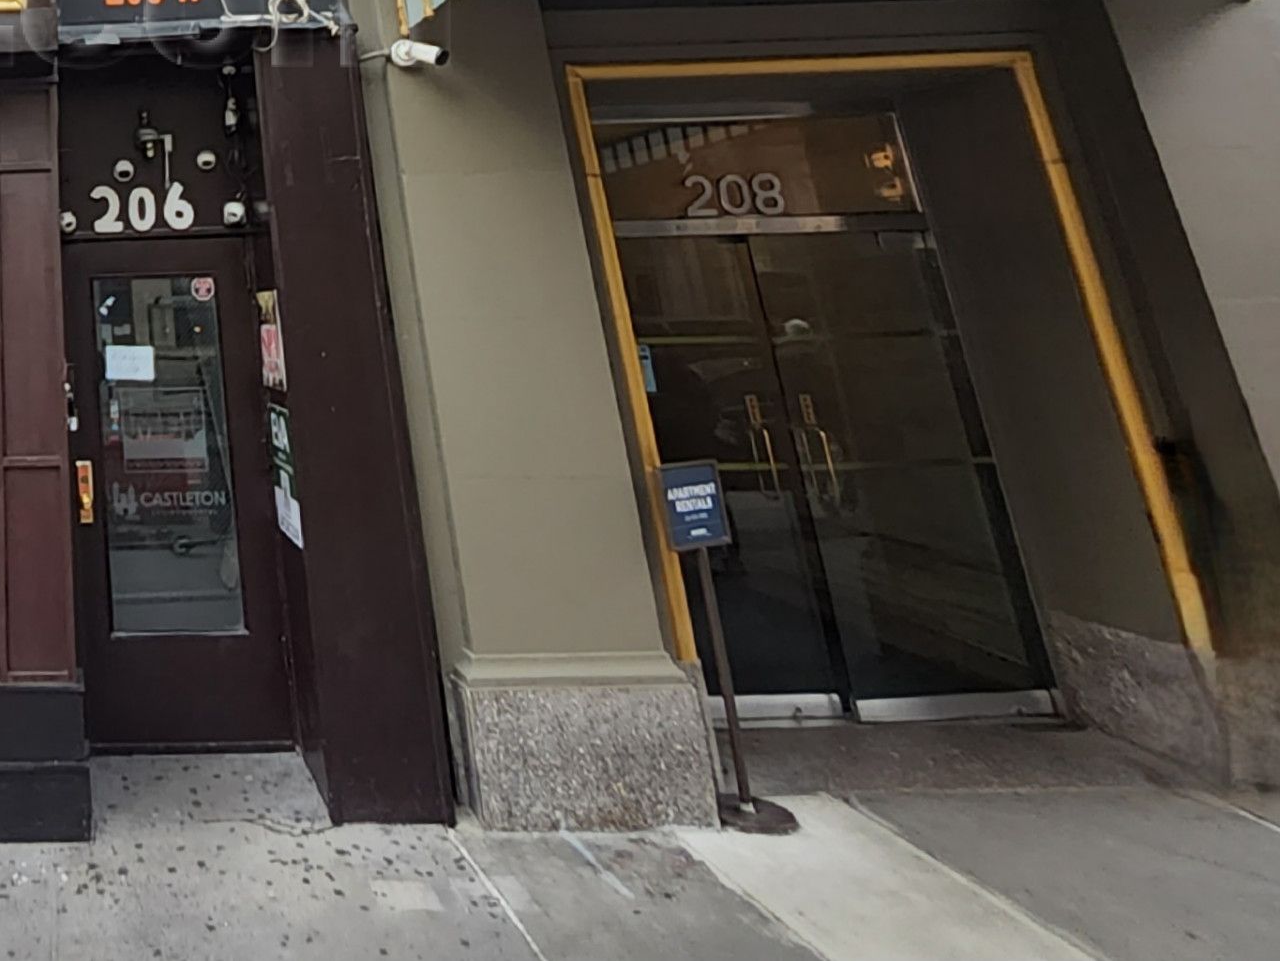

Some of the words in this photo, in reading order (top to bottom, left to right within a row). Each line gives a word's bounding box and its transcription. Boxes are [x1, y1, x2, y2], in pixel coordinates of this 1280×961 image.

[90, 181, 195, 233] 206
[684, 172, 785, 217] 208
[139, 490, 226, 508] CASTLETON
